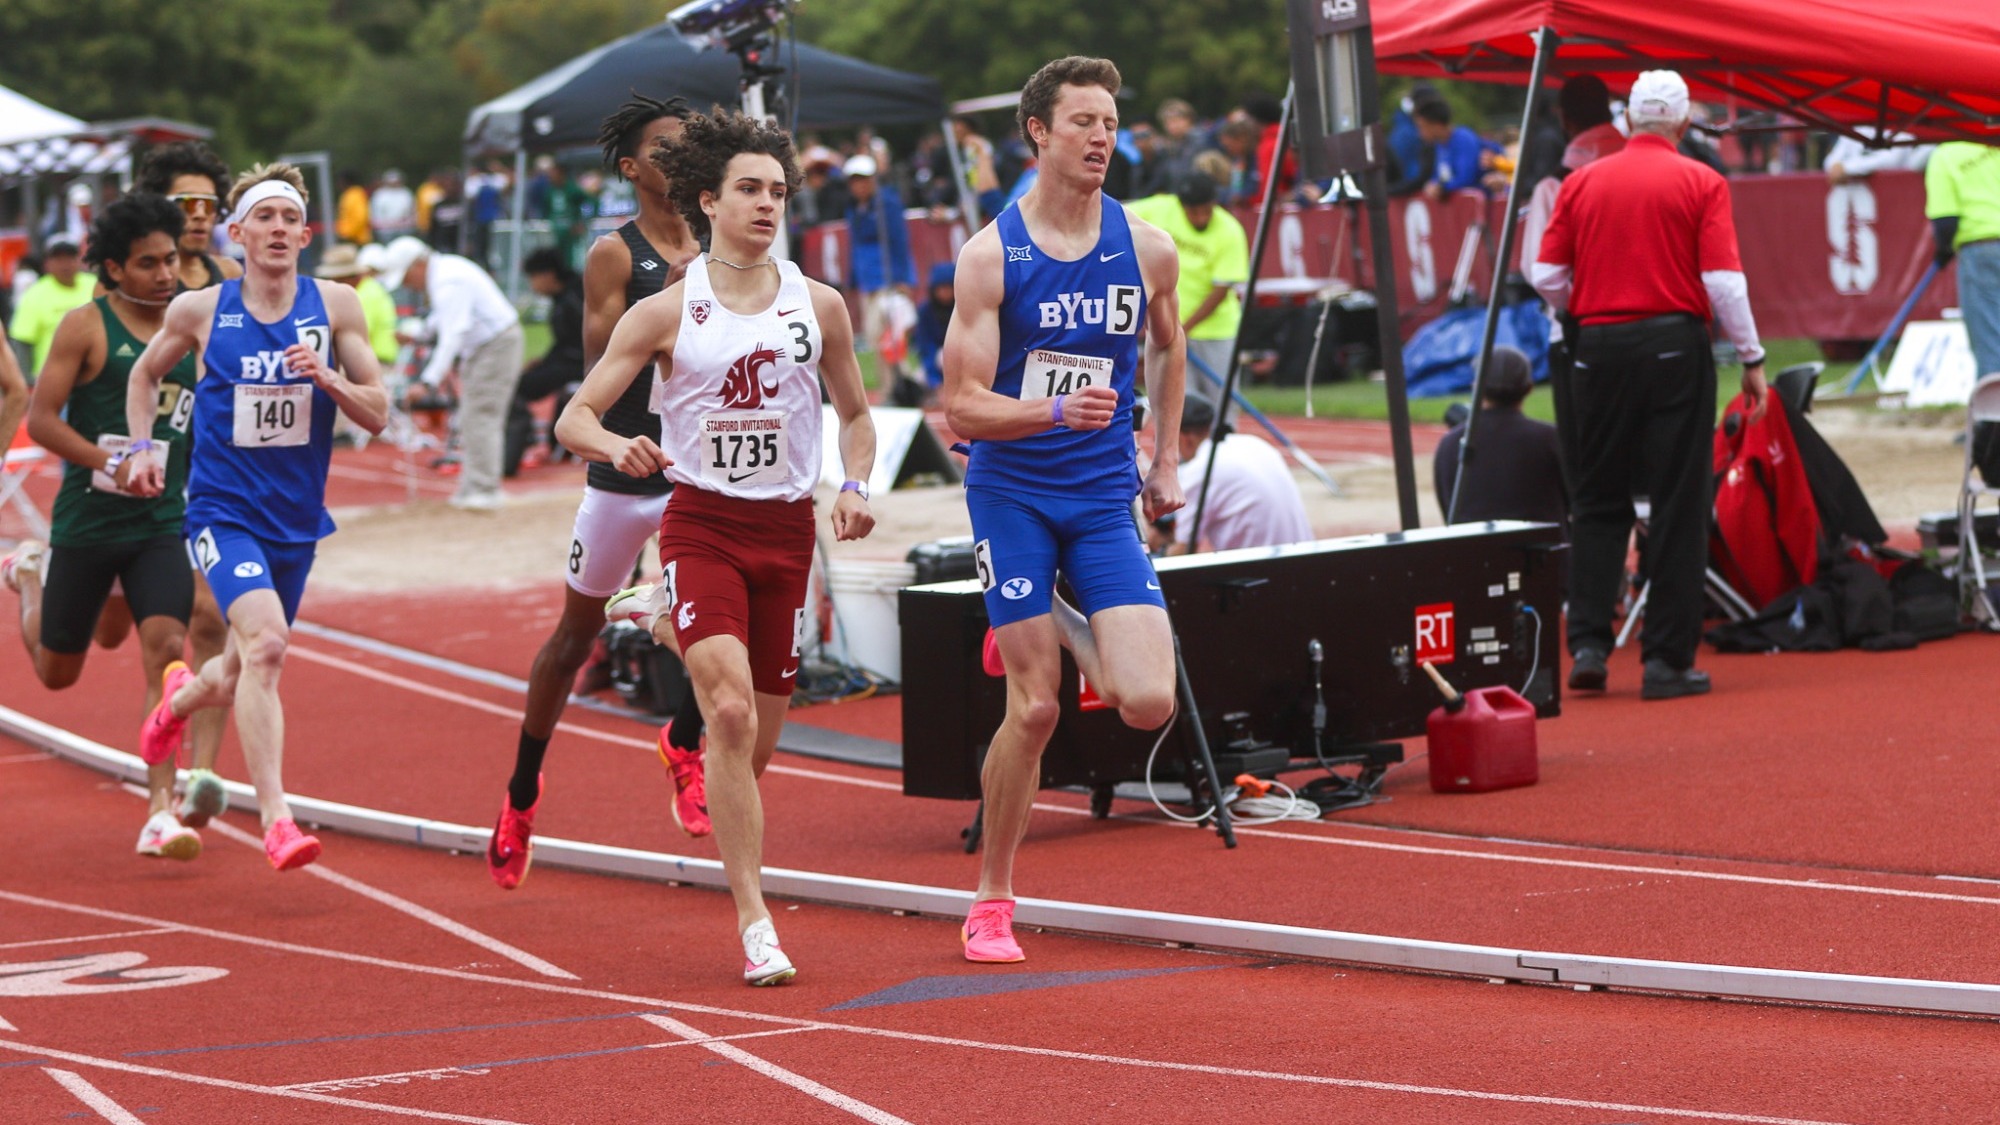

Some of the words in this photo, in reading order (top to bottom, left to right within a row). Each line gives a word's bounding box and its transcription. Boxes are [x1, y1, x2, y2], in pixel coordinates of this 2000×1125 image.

[1404, 200, 1437, 303] S
[1827, 183, 1879, 295] S
[1039, 291, 1105, 330] BYU
[1114, 288, 1135, 332] 5
[788, 321, 812, 364] 3
[1037, 352, 1078, 367] STANFORD
[1078, 360, 1104, 371] INVITE
[176, 394, 192, 427] 9
[253, 400, 295, 429] 140
[706, 420, 738, 432] STANFORD
[740, 418, 782, 432] INVITATIONAL
[711, 433, 778, 469] 1735
[198, 536, 215, 570] 2
[569, 539, 583, 575] 8
[975, 544, 990, 590] 5
[1006, 579, 1027, 598] Y
[1416, 611, 1453, 651] RT
